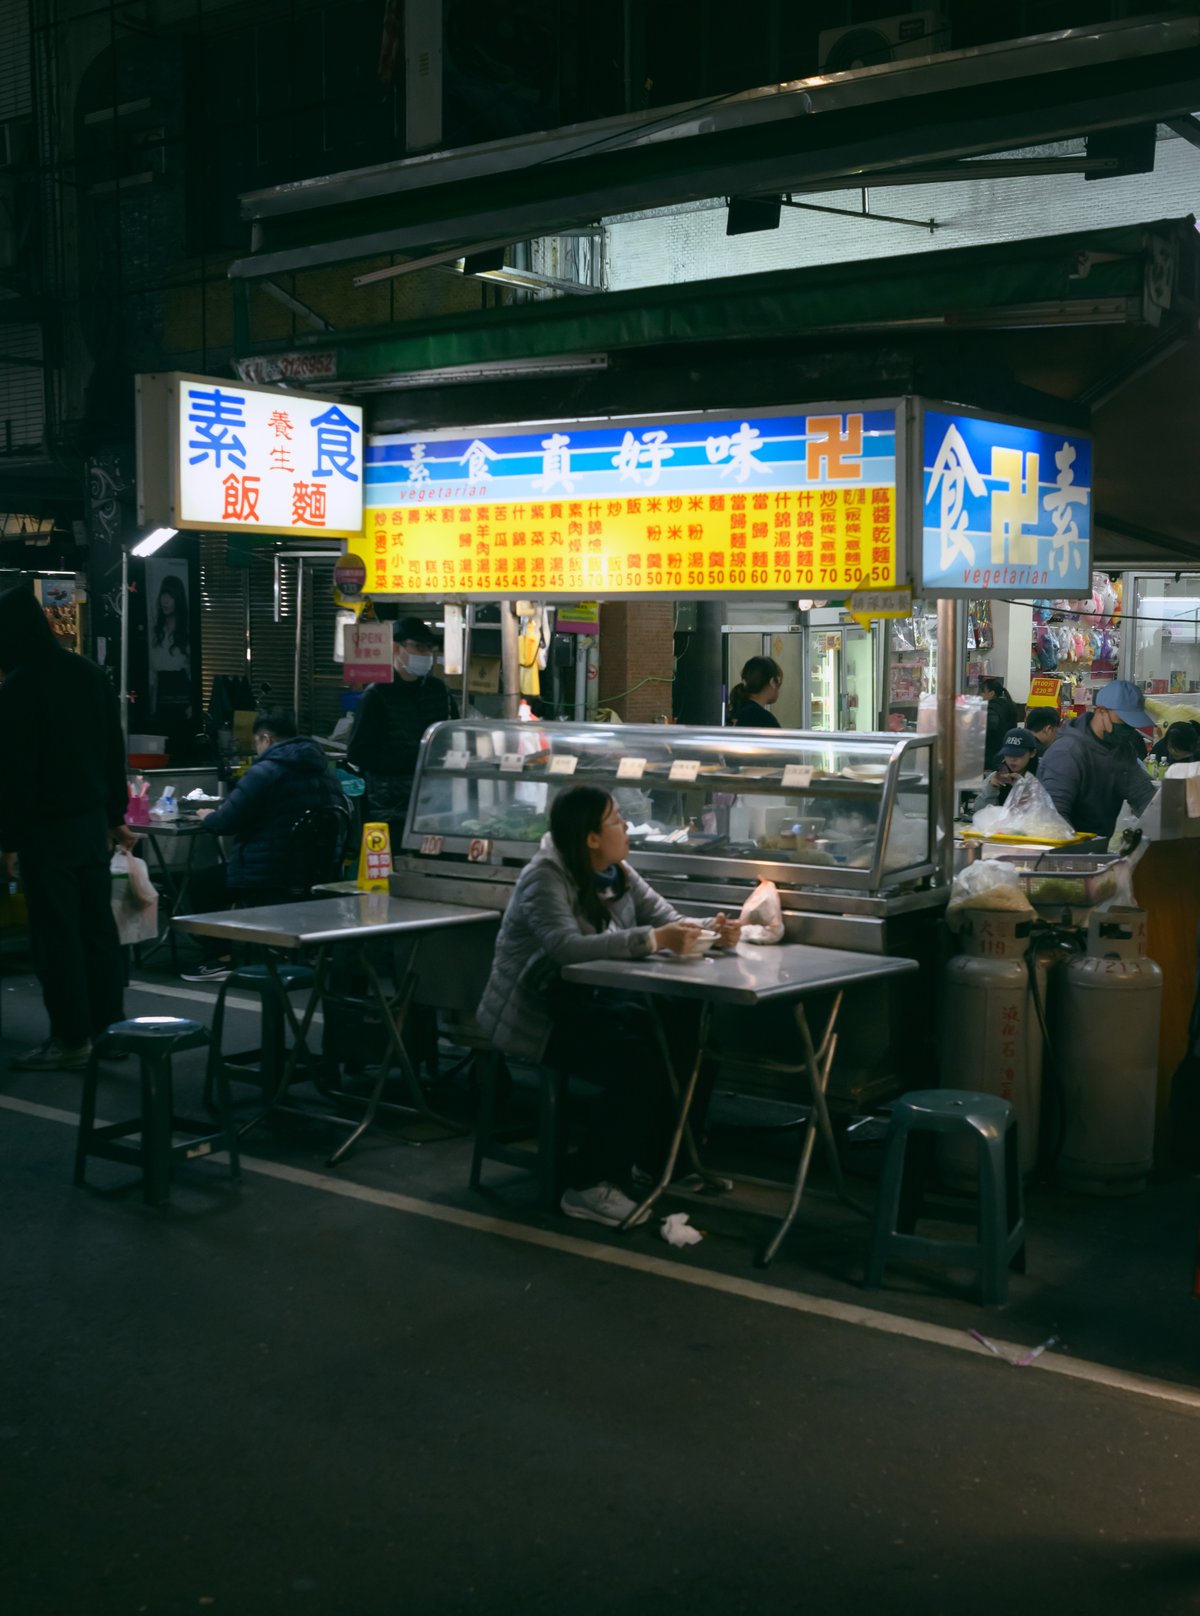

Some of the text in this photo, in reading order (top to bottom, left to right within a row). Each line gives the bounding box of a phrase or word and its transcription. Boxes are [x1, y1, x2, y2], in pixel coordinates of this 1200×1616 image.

[268, 410, 295, 473] 養生
[400, 485, 487, 502] vegetarian
[627, 573, 641, 586] 50
[647, 572, 662, 585] 50
[666, 572, 682, 585] 70
[688, 571, 704, 585] 50
[709, 570, 725, 584] 50
[730, 570, 746, 584] 60
[751, 570, 768, 584] 60
[774, 570, 791, 583] 70
[796, 569, 813, 583] 70
[820, 569, 837, 583] 70
[844, 568, 862, 582] 50
[872, 567, 890, 581] 50
[964, 567, 1048, 588] vegetarian
[408, 577, 420, 588] 60
[426, 576, 438, 588] 40
[442, 576, 455, 588] 35
[460, 576, 473, 588] 45
[477, 576, 490, 588] 45
[495, 576, 509, 588] 45
[512, 575, 526, 587] 45
[532, 575, 545, 587] 25
[550, 575, 564, 587] 45
[569, 575, 583, 587] 35
